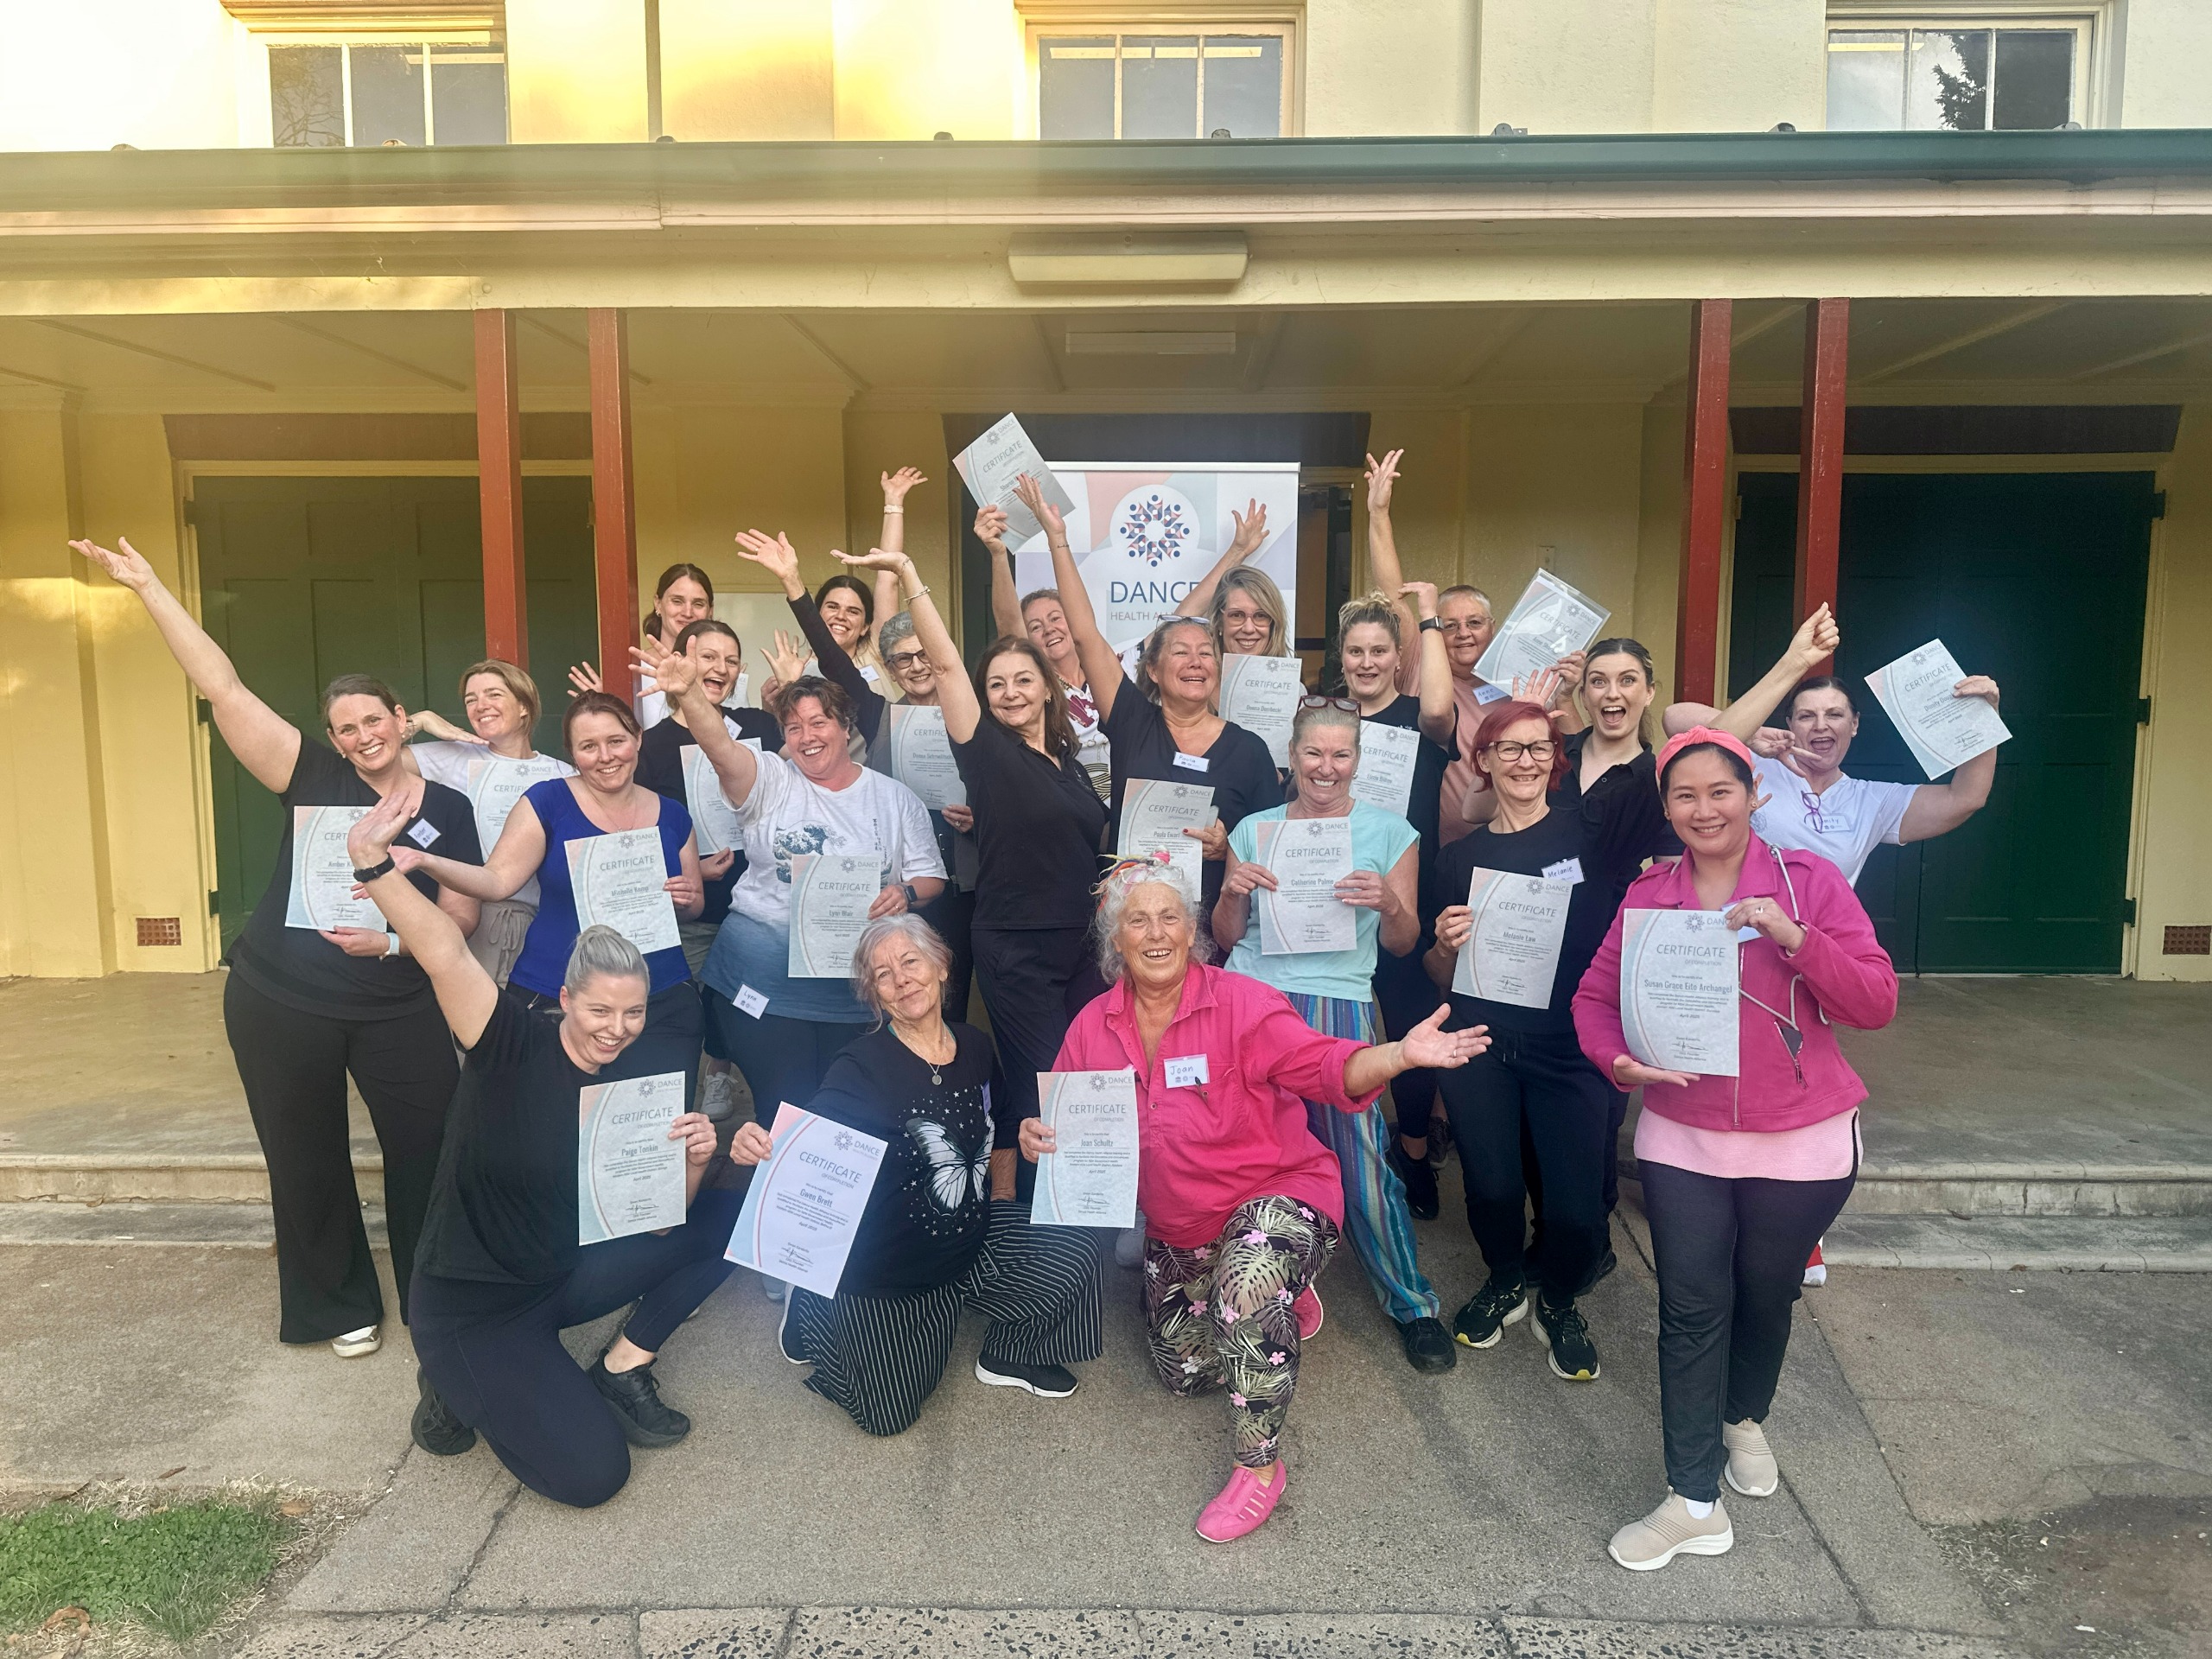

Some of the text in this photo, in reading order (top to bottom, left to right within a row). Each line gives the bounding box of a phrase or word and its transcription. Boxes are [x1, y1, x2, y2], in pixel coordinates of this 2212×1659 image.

[982, 441, 1022, 473] CERTIFICATE
[1110, 612, 1150, 620] HEALTH
[1540, 612, 1581, 639] CERTIFICATE
[1904, 663, 1952, 692] CERTIFICATE
[1245, 679, 1292, 690] CERTIFICATE
[1363, 747, 1408, 763] CERTIFICATE
[1148, 804, 1200, 817] CERTIFICATE
[636, 832, 658, 841] DANCE
[1286, 848, 1342, 858] CERTIFICATE
[600, 855, 655, 872] CERTIFICATE
[1548, 866, 1573, 878] Melanie
[818, 881, 871, 892] CERTIFICATE
[1546, 883, 1570, 893] DANCE
[1498, 901, 1557, 918] CERTIFICATE
[1656, 944, 1726, 958] CERTIFICATE
[1644, 979, 1663, 988] Susan
[1664, 981, 1683, 990] Grace
[1699, 983, 1732, 995] Archangel
[1169, 1065, 1193, 1075] Joan
[658, 1078, 683, 1088] DANCE
[612, 1107, 673, 1125] CERTIFICATE
[1069, 1104, 1127, 1115] CERTIFICATE
[622, 1145, 658, 1157] Paige Tonkin
[855, 1141, 880, 1157] DANCE
[799, 1151, 862, 1184] CERTIFICATE
[799, 1189, 833, 1208] Gwen Brett
